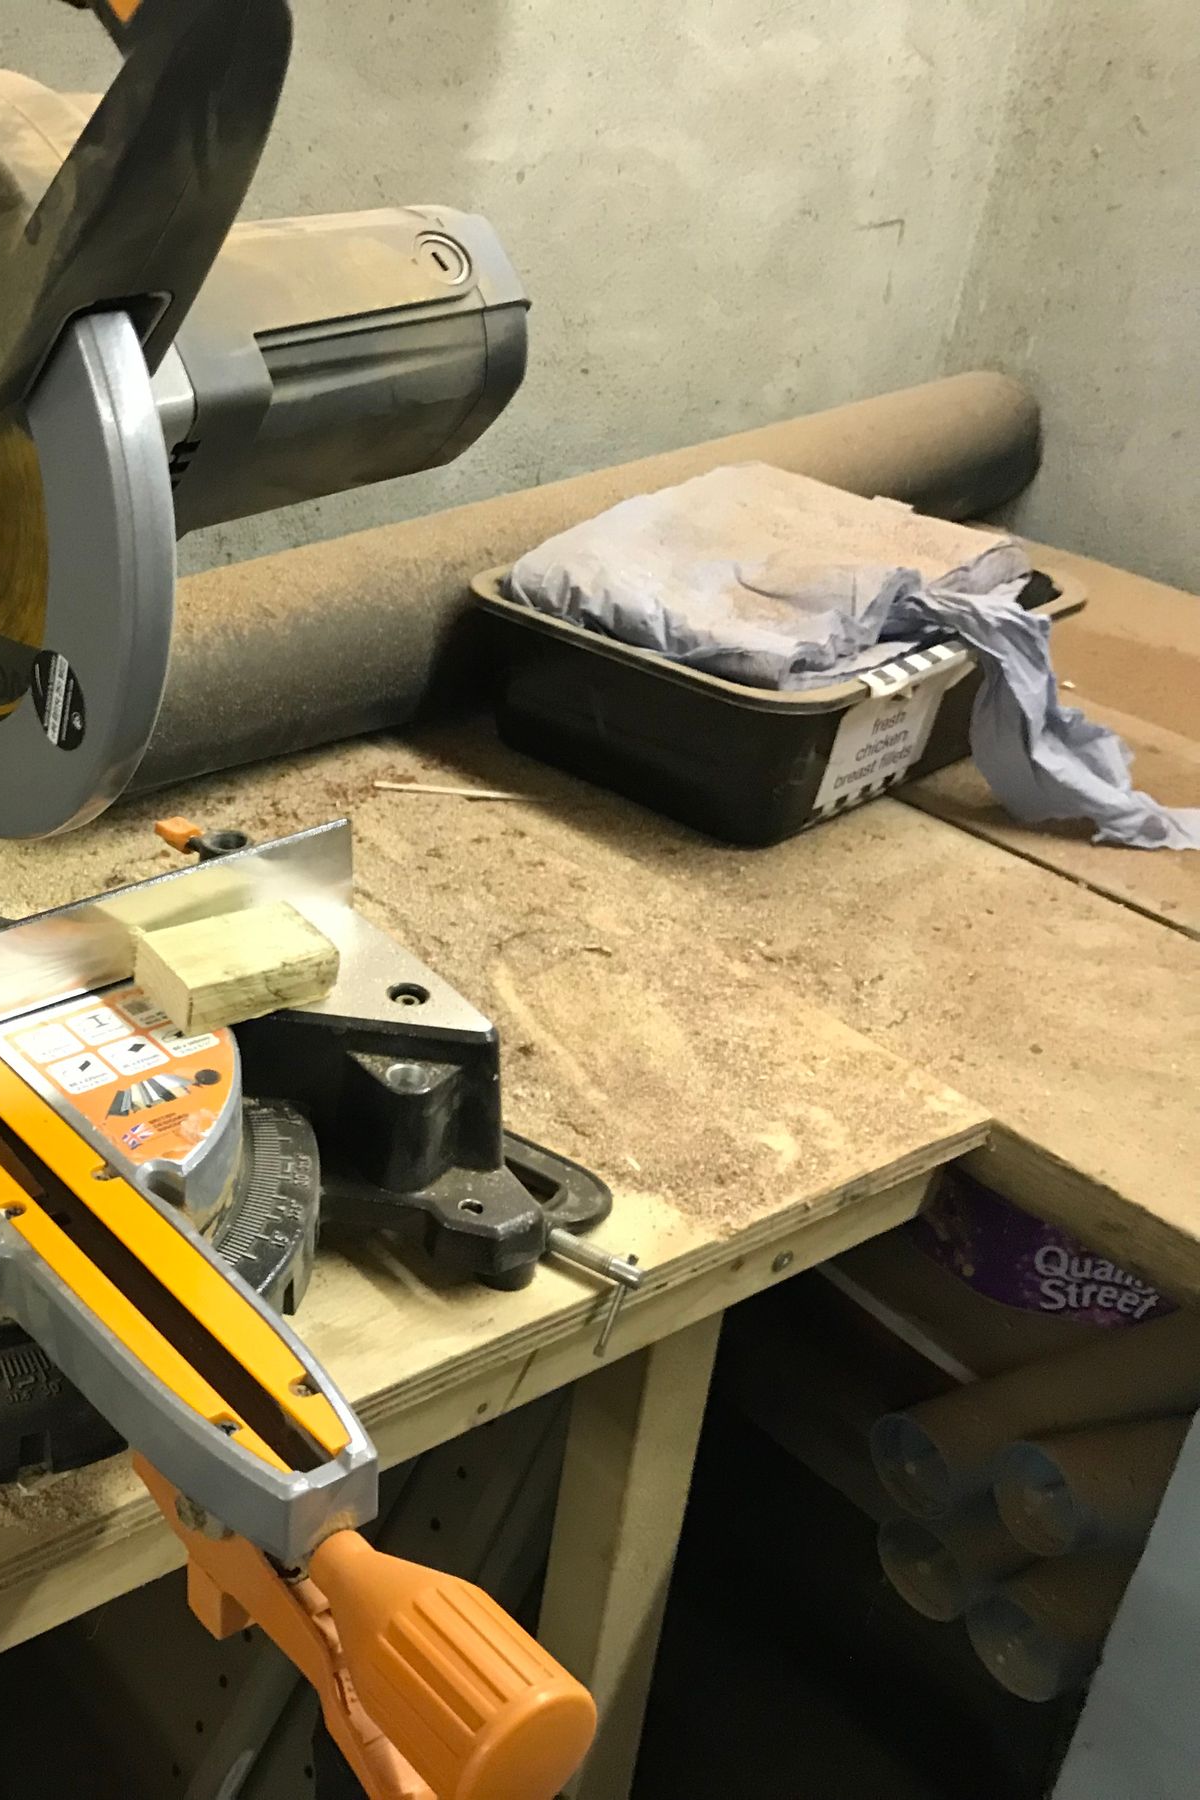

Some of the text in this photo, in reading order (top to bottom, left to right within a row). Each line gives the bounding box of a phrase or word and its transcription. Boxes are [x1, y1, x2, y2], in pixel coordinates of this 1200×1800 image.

[872, 711, 907, 736] fresh
[855, 730, 910, 762] chicken
[833, 760, 877, 790] breast
[1039, 1278, 1160, 1319] Street
